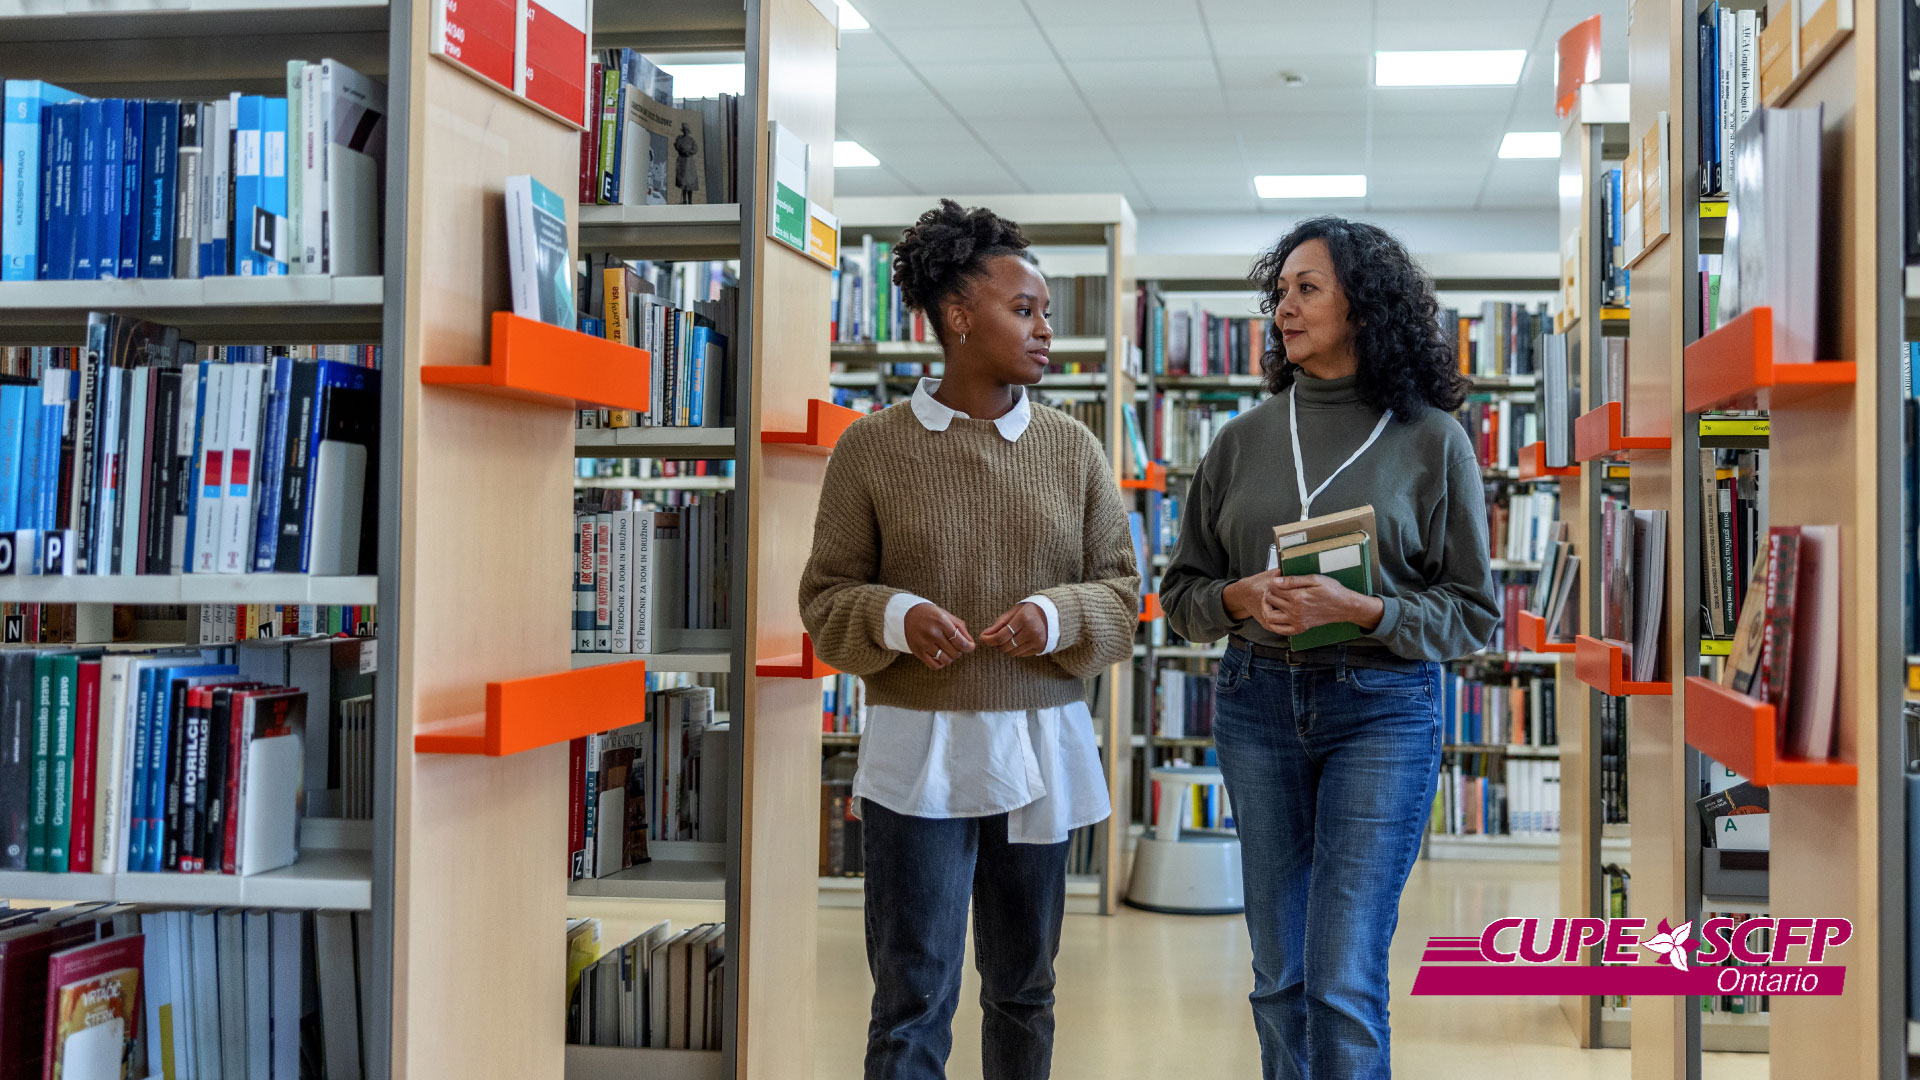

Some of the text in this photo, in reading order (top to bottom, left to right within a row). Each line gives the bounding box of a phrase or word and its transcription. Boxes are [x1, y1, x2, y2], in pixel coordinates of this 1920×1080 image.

[446, 22, 465, 43] 4/340
[446, 42, 461, 58] ravo
[1741, 49, 1751, 80] Graphic
[1740, 82, 1750, 107] Design
[183, 114, 196, 127] 24
[16, 150, 25, 226] KAZENSKO PRAVO
[604, 176, 611, 197] E
[1702, 168, 1707, 189] A
[1716, 167, 1721, 188] B
[154, 178, 163, 207] zakonik
[152, 208, 162, 241] Kazenski
[260, 214, 272, 249] L
[609, 302, 620, 327] skoraj
[613, 330, 620, 339] za
[85, 351, 98, 402] Crime
[83, 402, 95, 448] SCENE
[598, 526, 608, 545] DRUŽINO
[618, 518, 626, 551] DRUŽINO
[639, 519, 648, 552] DRUŽINO
[1723, 528, 1731, 556] grafična
[47, 536, 61, 570] P
[581, 523, 593, 584] ABC GOSPODINJSTVA
[600, 555, 608, 565] DOM
[1724, 556, 1732, 581] podoba
[598, 576, 608, 605] NASVETOV
[619, 584, 625, 593] ZA
[641, 585, 647, 594] ZA
[615, 595, 625, 635] PRIROČNIK
[637, 596, 646, 636] PRIROČNIK
[9, 620, 19, 640] N
[260, 627, 270, 639] N
[35, 676, 50, 824] Gospodarsko kazensko pravo
[53, 676, 70, 826] Gospodarsko kazensko pravo
[184, 718, 198, 804] MORILCI
[198, 719, 208, 779] MORILCI
[101, 789, 114, 860] Kazensko pravo
[1725, 818, 1737, 832] A
[575, 856, 582, 876] Z
